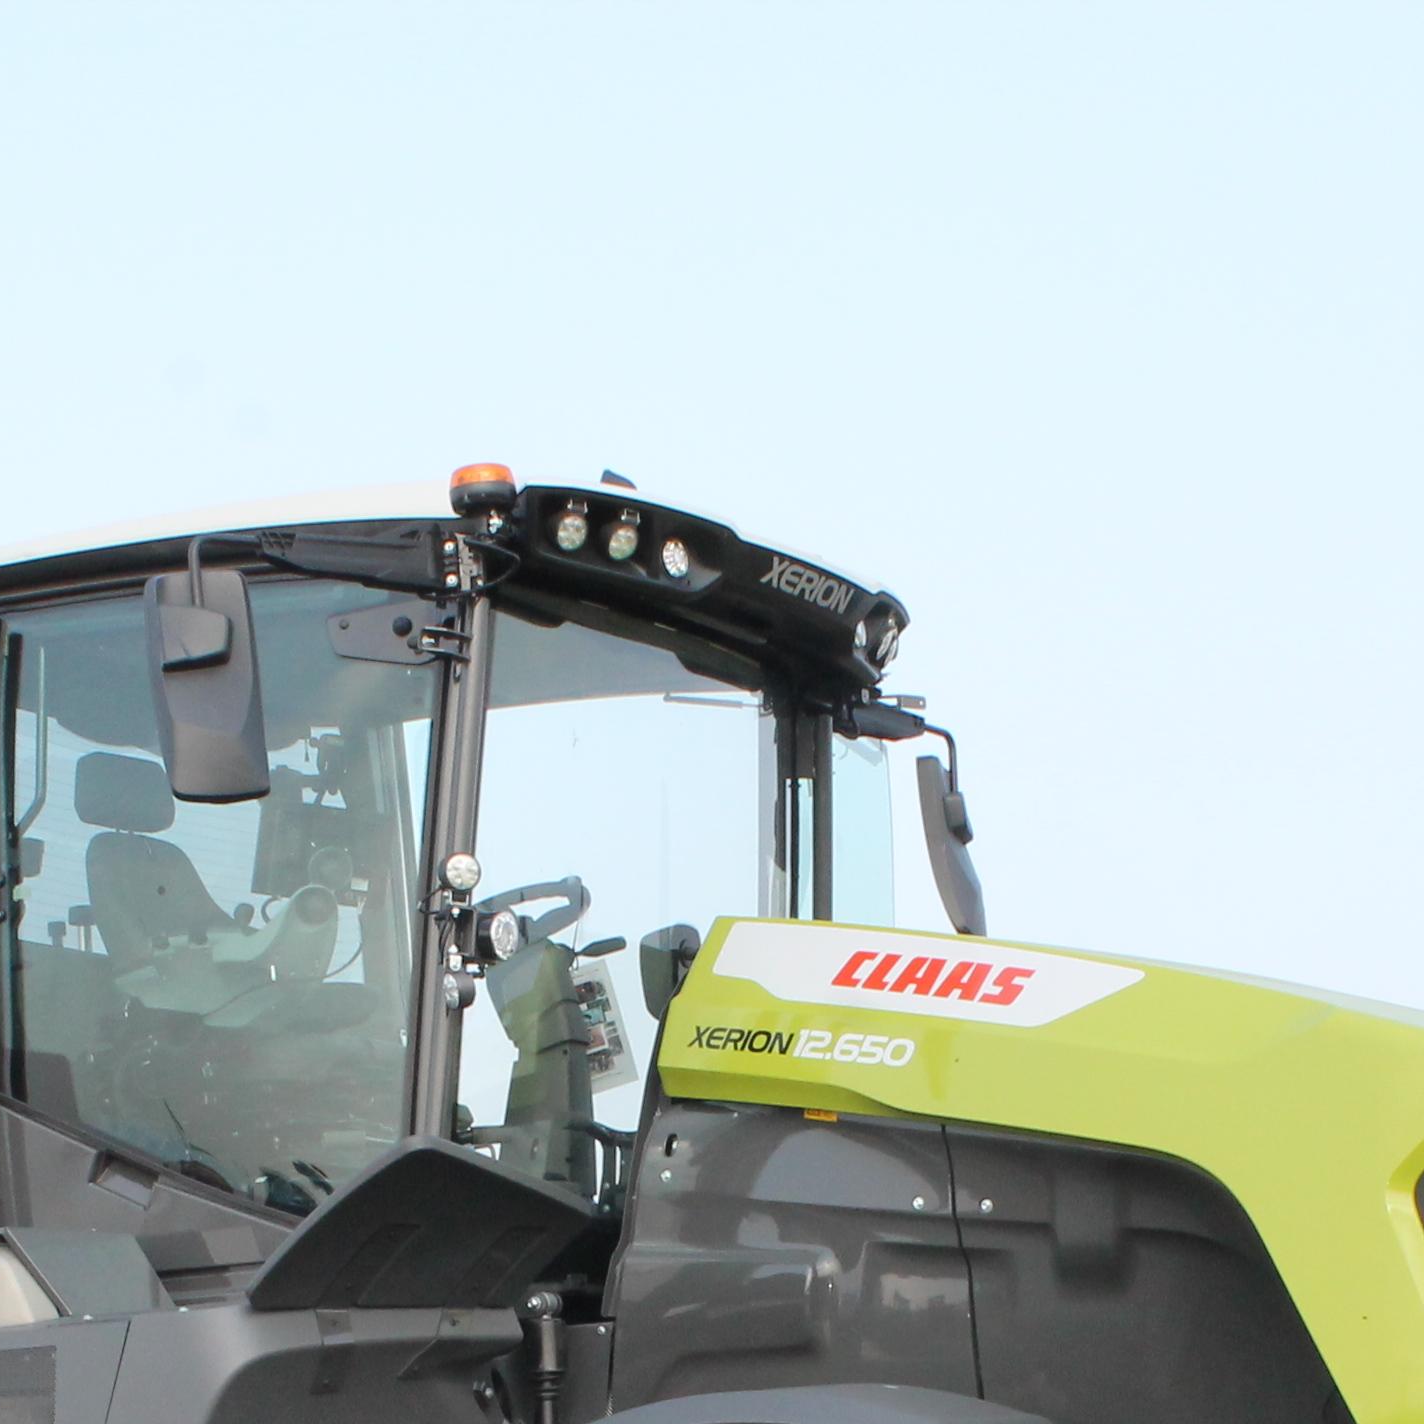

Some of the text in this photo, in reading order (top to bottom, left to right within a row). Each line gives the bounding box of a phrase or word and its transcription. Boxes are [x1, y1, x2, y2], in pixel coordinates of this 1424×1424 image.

[760, 556, 854, 614] XERION
[831, 951, 1036, 1006] CLAAS
[688, 1026, 915, 1067] XERION 12.650
